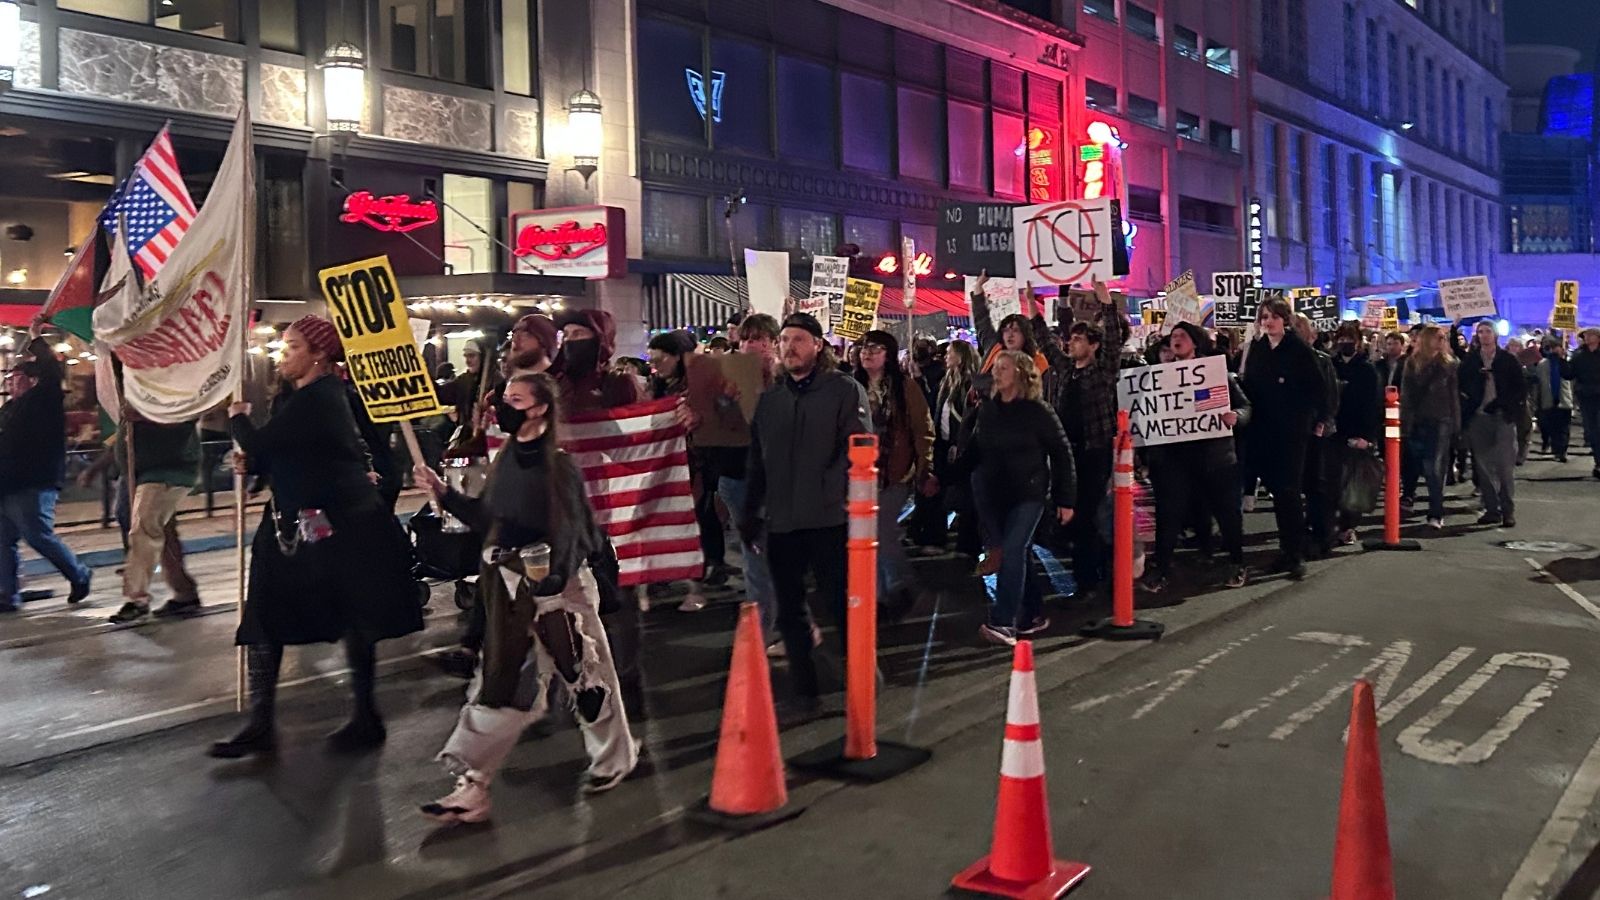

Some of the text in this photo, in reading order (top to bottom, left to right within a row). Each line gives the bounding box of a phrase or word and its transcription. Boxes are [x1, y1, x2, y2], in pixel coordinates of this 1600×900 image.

[946, 207, 1013, 227] NO HUMA
[972, 233, 1014, 252] ILLEGA
[1022, 207, 1104, 270] ICE
[1250, 203, 1263, 288] PARKING
[325, 265, 397, 339] STOP
[1299, 295, 1337, 310] ICE
[349, 344, 421, 381] ICE TERROR
[358, 374, 430, 402] NOW!
[1124, 364, 1205, 395] ICE IS
[1128, 391, 1193, 419] ANTI-
[1130, 412, 1232, 440] AMERICAN
